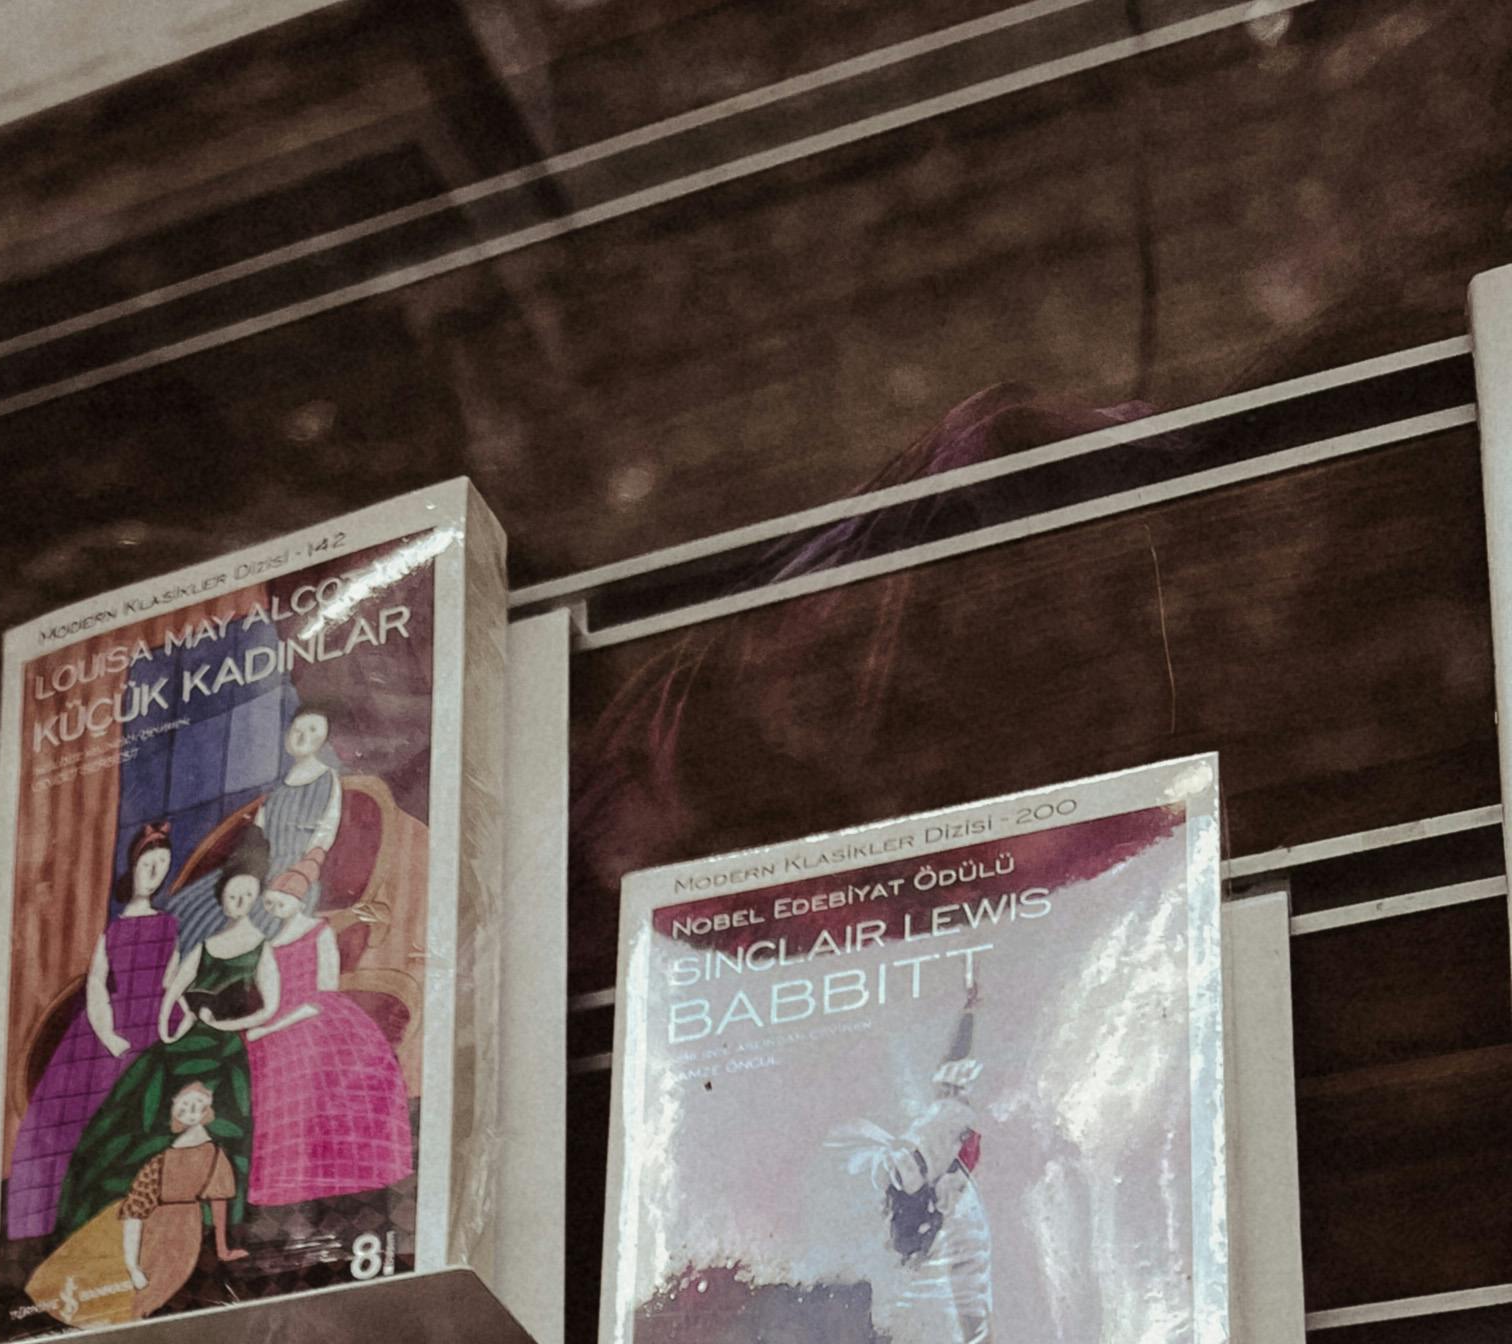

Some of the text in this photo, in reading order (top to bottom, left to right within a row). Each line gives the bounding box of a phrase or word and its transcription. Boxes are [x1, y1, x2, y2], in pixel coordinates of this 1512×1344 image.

[34, 573, 358, 700] LOUISA MAY ALCO
[39, 609, 117, 645] MODERN
[307, 531, 347, 557] 142
[33, 677, 170, 752] KÜÇÜK
[183, 604, 412, 703] KADINLAR
[672, 852, 1016, 940] NOBEL EDEBİYAT ÖDÜLÜ
[674, 864, 776, 895] MODERN
[784, 834, 915, 872] KLASİKLER
[1015, 798, 1079, 826] 200
[669, 887, 1053, 987] SINCLAIR LEWIS
[668, 943, 995, 1045] BABBITT
